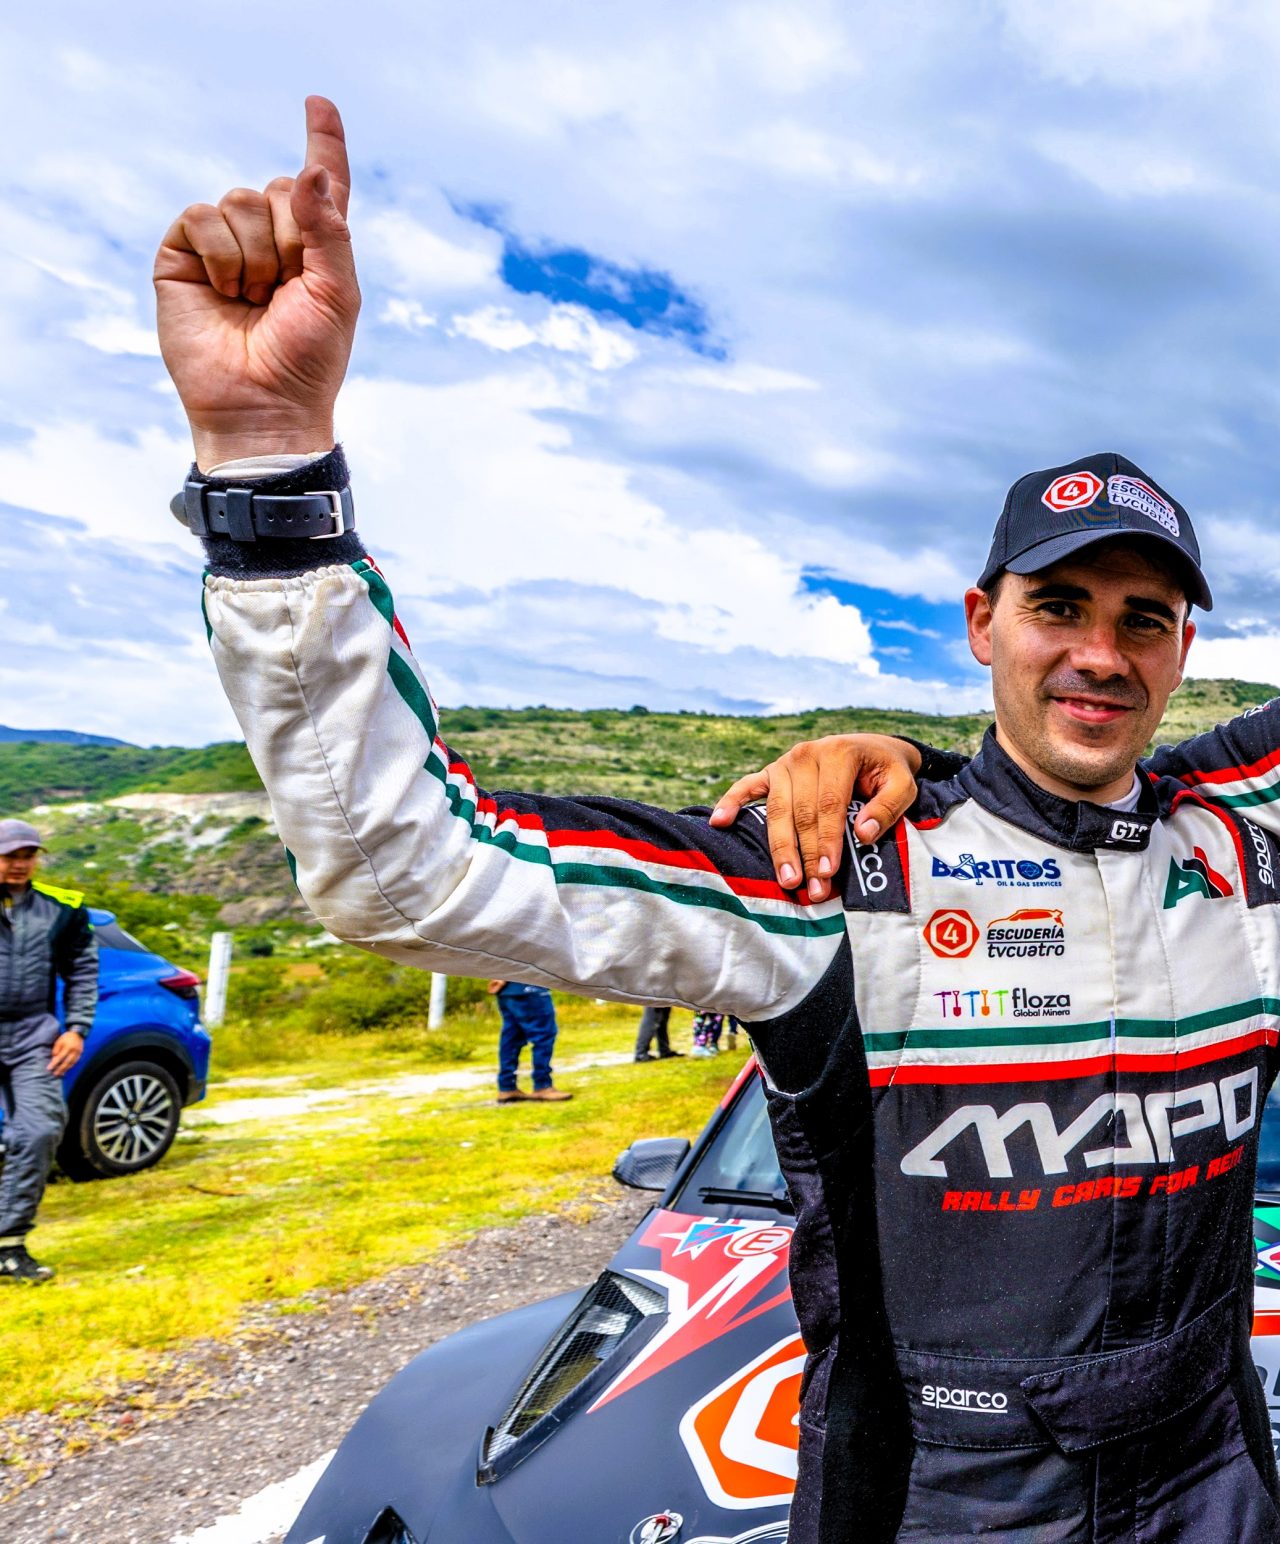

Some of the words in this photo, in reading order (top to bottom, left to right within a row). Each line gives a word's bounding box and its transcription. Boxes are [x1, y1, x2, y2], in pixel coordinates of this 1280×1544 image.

[1063, 483, 1080, 497] 4
[1111, 493, 1178, 535] tvcuatro
[931, 854, 1061, 885] BARITOS
[942, 923, 959, 944] 4
[987, 925, 1065, 941] ESCUDERÍA
[987, 942, 1065, 958] tvcuatro
[1011, 987, 1071, 1009] floza
[1013, 1009, 1041, 1018] Global
[1042, 1008, 1071, 1017] Minera
[941, 1188, 1042, 1211] RALLY
[1051, 1175, 1144, 1208] CARS
[1149, 1165, 1201, 1196] FOR
[1206, 1145, 1245, 1182] RENT
[921, 1385, 1008, 1411] sparco
